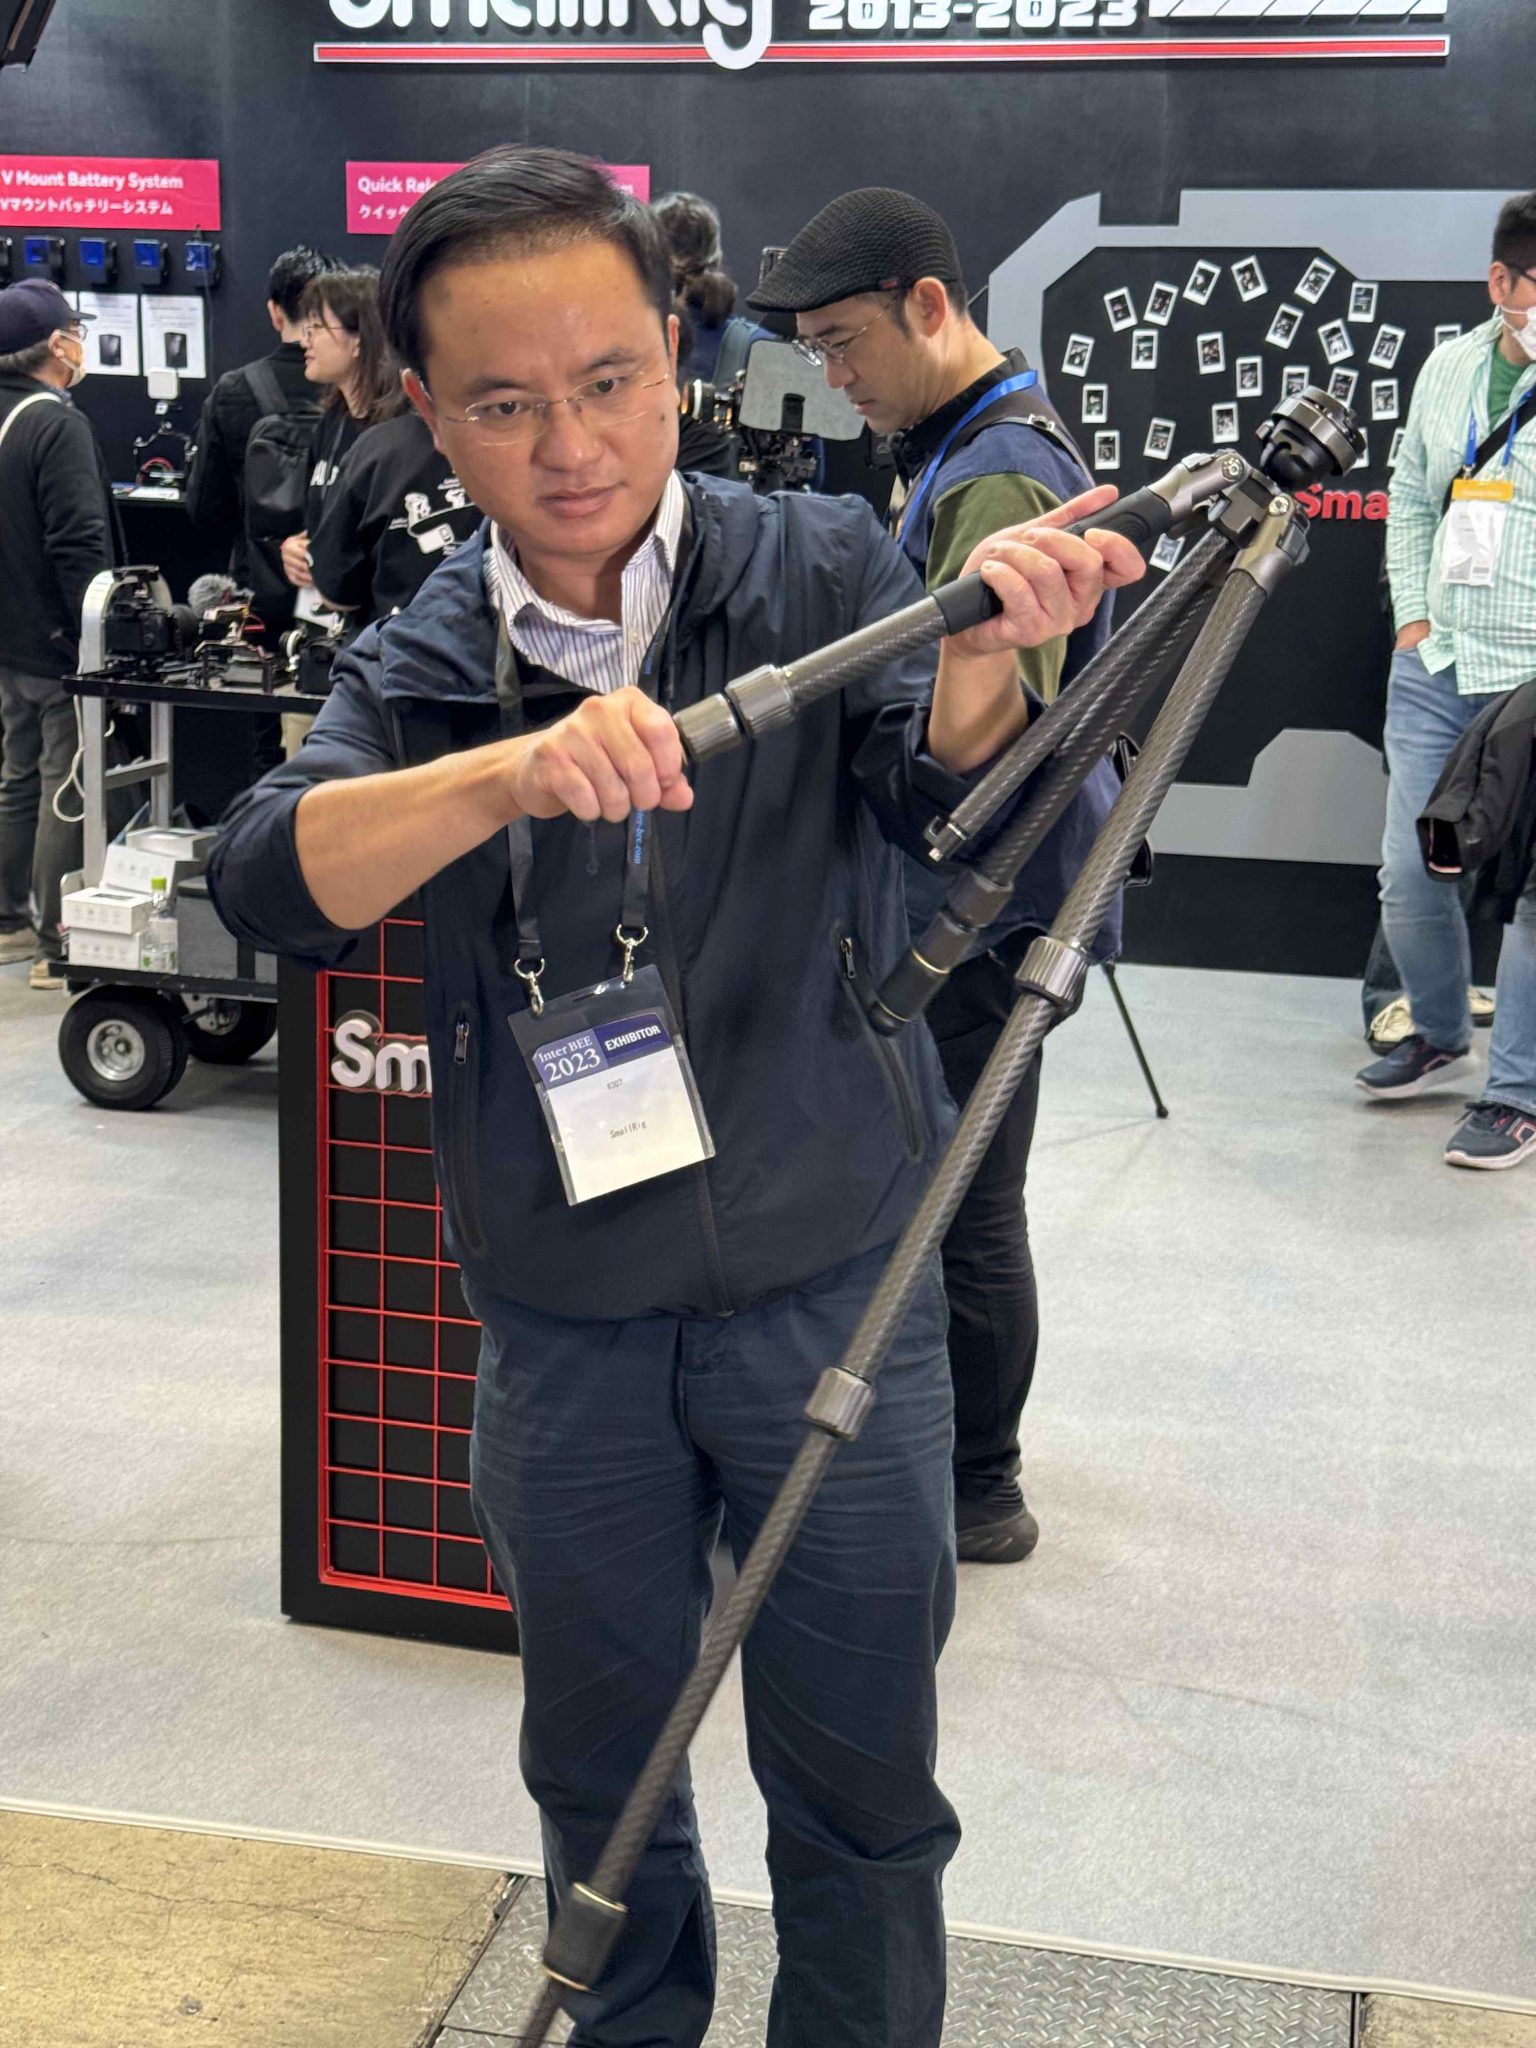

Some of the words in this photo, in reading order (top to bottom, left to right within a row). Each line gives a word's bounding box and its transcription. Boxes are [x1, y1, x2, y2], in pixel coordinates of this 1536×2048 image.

[1, 169, 14, 186] V
[16, 170, 66, 187] Mount
[67, 172, 125, 192] Battery
[127, 173, 184, 192] System
[357, 176, 403, 195] Quick
[538, 1046, 568, 1063] Inter
[568, 1035, 593, 1053] BEE
[604, 1024, 661, 1051] EXHIBITOR
[544, 1048, 601, 1082] 2023
